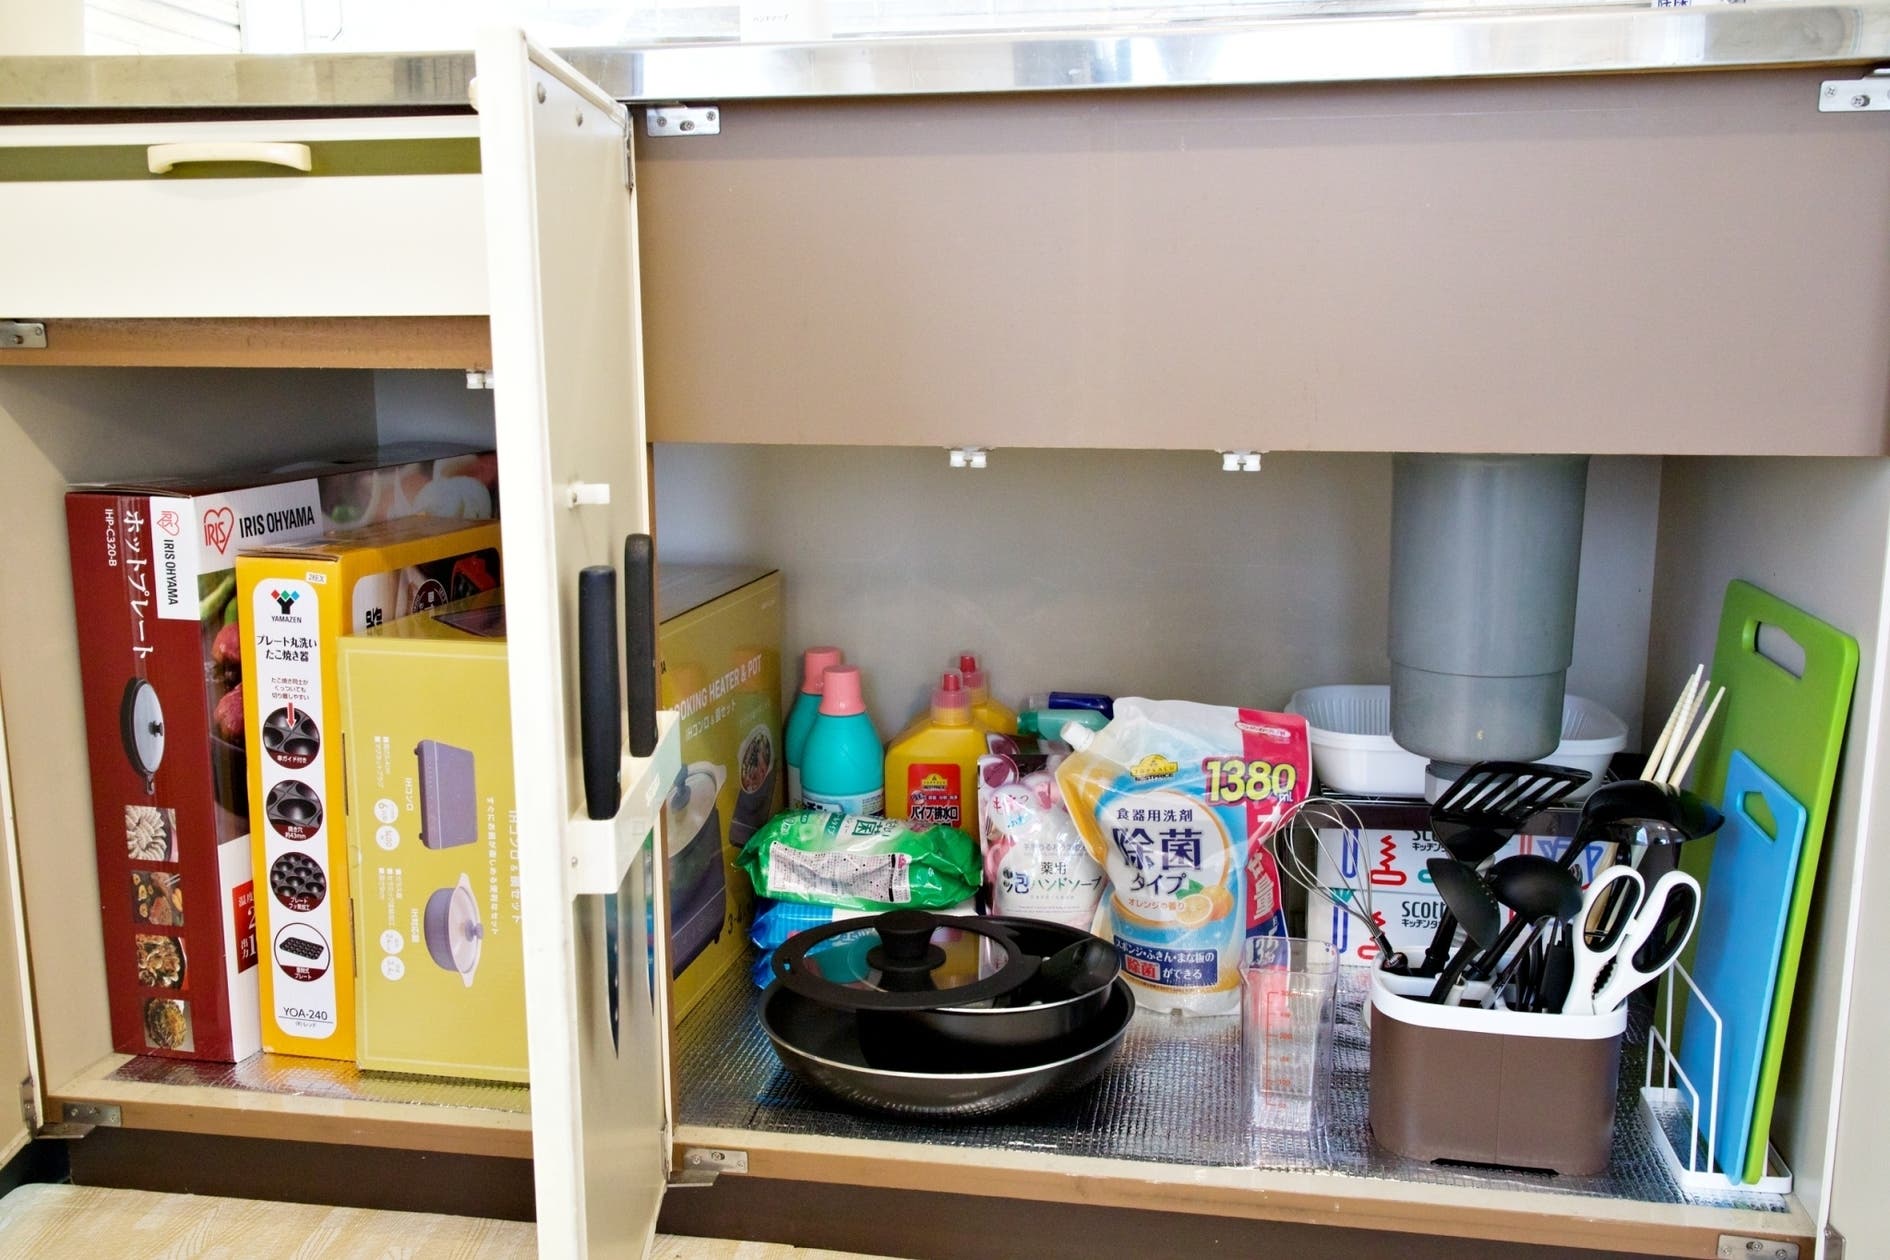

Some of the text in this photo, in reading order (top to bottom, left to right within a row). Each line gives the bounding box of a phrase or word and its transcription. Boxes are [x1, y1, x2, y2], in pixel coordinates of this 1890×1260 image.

[239, 505, 315, 539] IRIS OHYAMA
[104, 508, 117, 567] IHP-C320-B
[163, 538, 179, 606] IRIS OHYAMA
[123, 509, 153, 659] ホットプレート
[271, 615, 302, 624] YAMAZEN
[256, 635, 317, 649] プレート丸洗い
[265, 649, 309, 662] たこ焼き器
[709, 668, 740, 702] HEATER
[748, 653, 762, 677] POT
[1206, 760, 1297, 801] 1380
[1116, 807, 1193, 822] 食器用洗剤
[1112, 828, 1202, 871] 除菌
[1130, 872, 1187, 895] タイプ
[1128, 898, 1185, 910] オレンジの香り
[1401, 918, 1441, 929] キッチンタ
[283, 1006, 328, 1021] YOA-240
